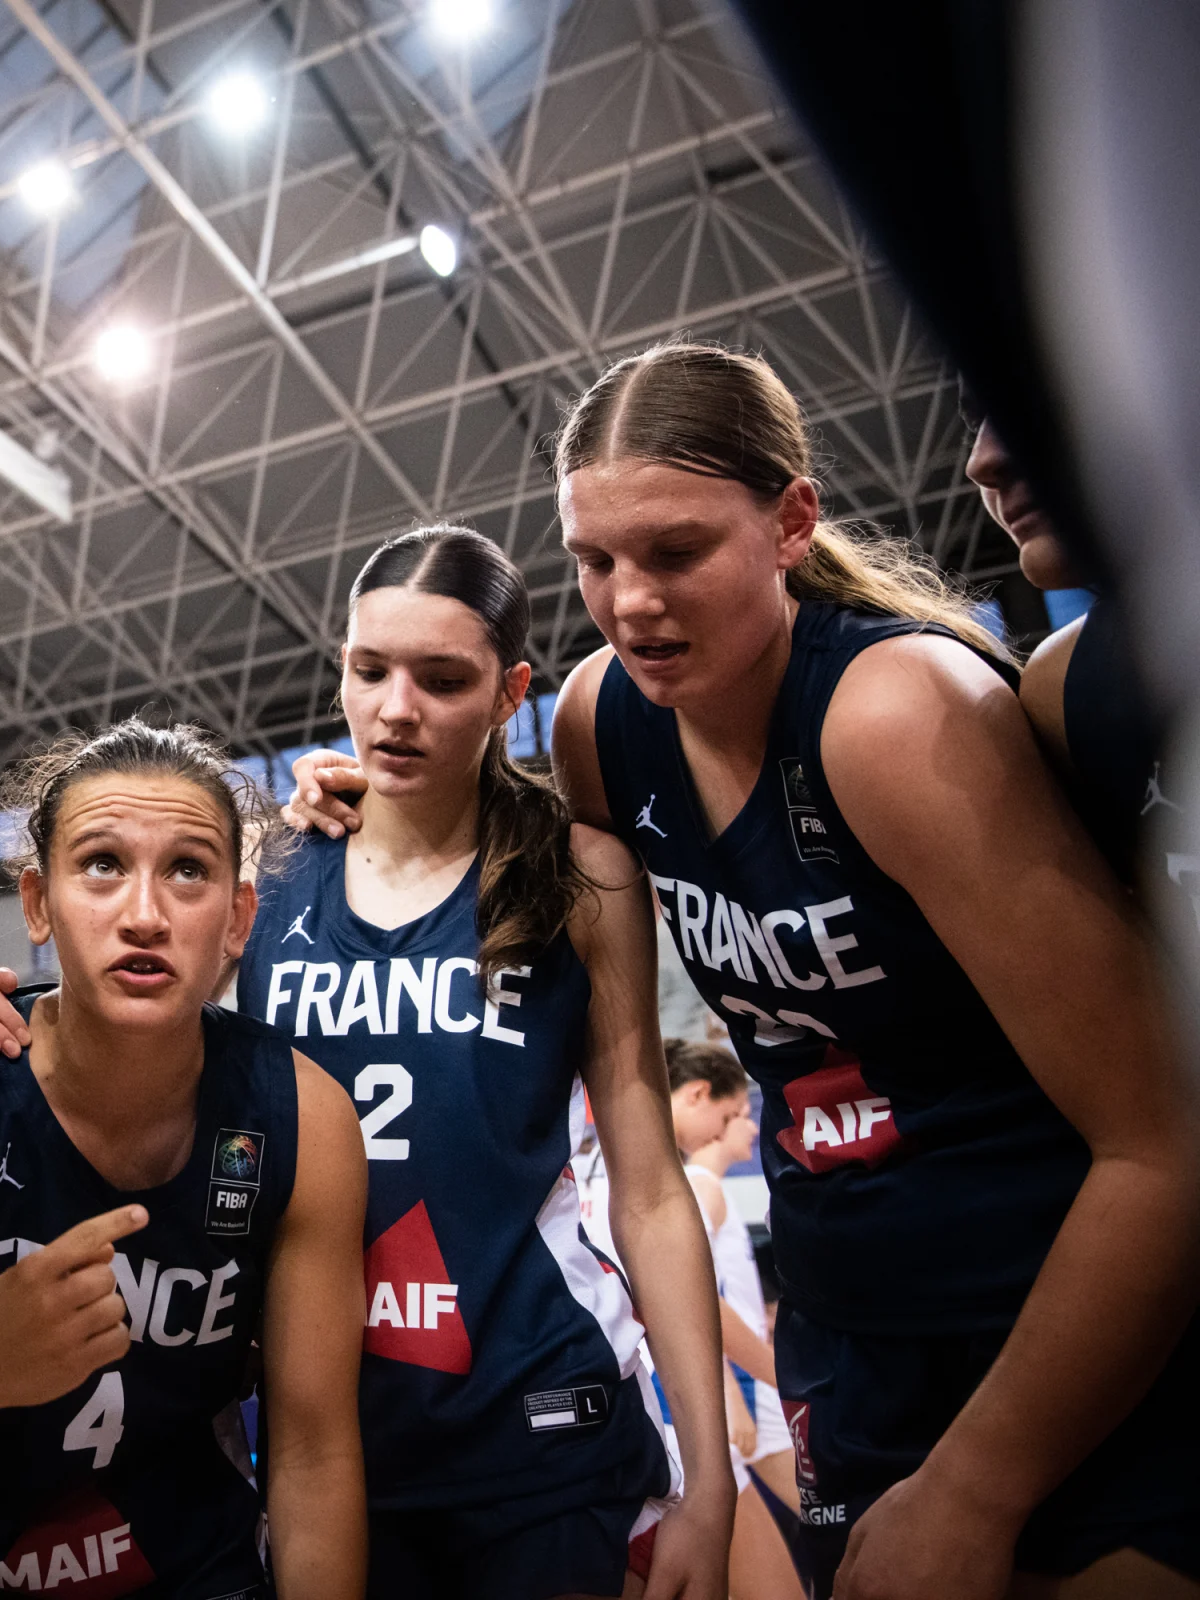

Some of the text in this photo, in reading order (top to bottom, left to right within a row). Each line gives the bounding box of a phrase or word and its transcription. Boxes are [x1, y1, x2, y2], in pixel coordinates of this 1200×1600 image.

[649, 870, 888, 991] FRANCE
[266, 956, 533, 1048] FRANCE
[800, 1096, 891, 1151] AIF
[216, 1190, 248, 1209] FIBA
[364, 1281, 459, 1330] AIF
[62, 1370, 125, 1470] 4
[586, 1397, 598, 1413] L
